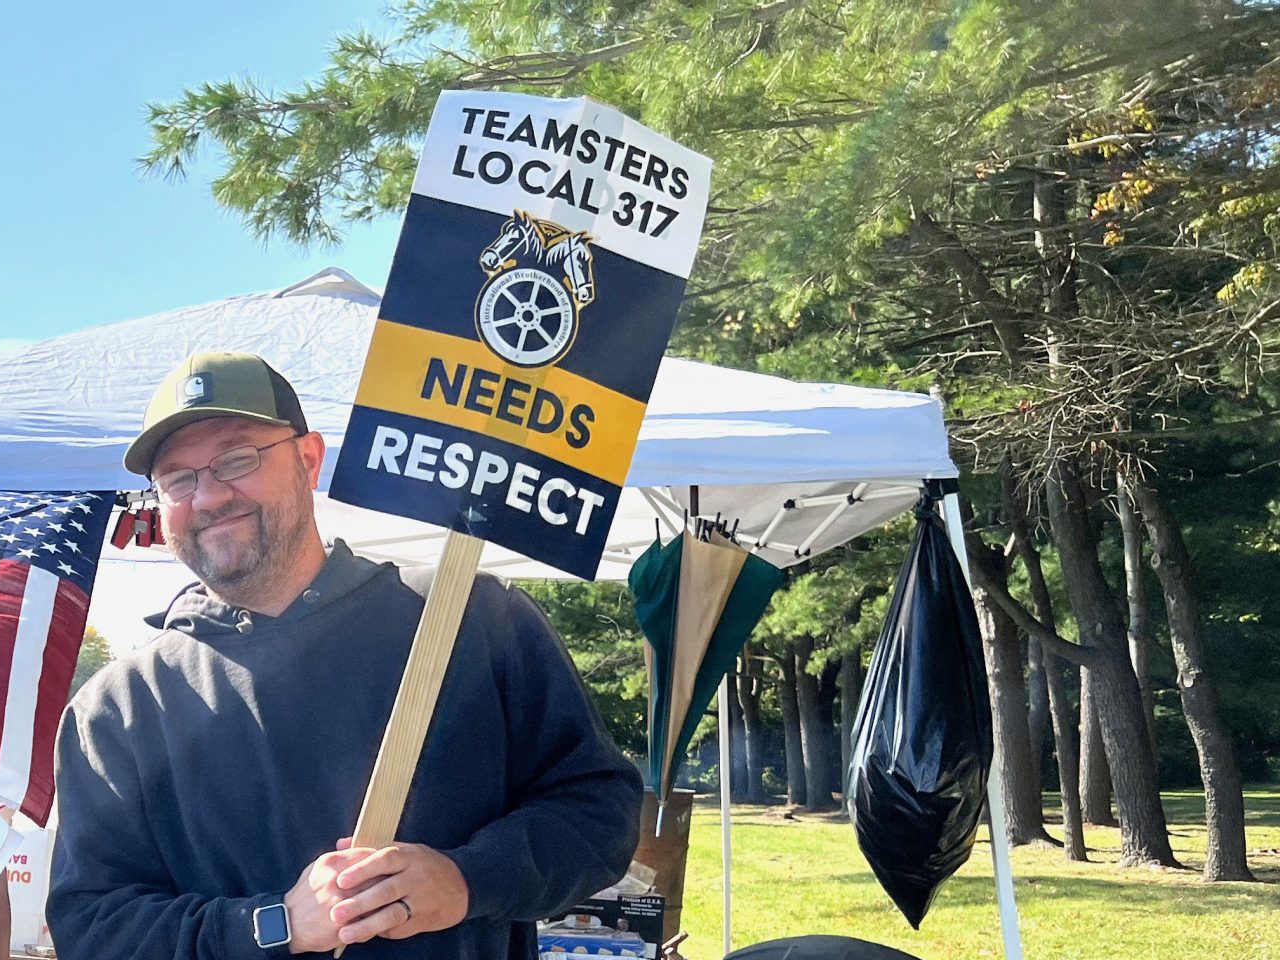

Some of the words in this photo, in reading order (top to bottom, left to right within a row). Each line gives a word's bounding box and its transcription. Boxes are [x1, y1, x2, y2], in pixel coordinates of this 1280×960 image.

[452, 145, 600, 215] LOCAL
[612, 191, 680, 238] 317
[461, 107, 690, 200] TEAMSTERS
[483, 275, 513, 324] International
[514, 271, 564, 297] Brotherhood
[553, 310, 570, 349] Teamsters
[419, 357, 596, 450] NEEDS
[366, 425, 604, 536] RESPECT
